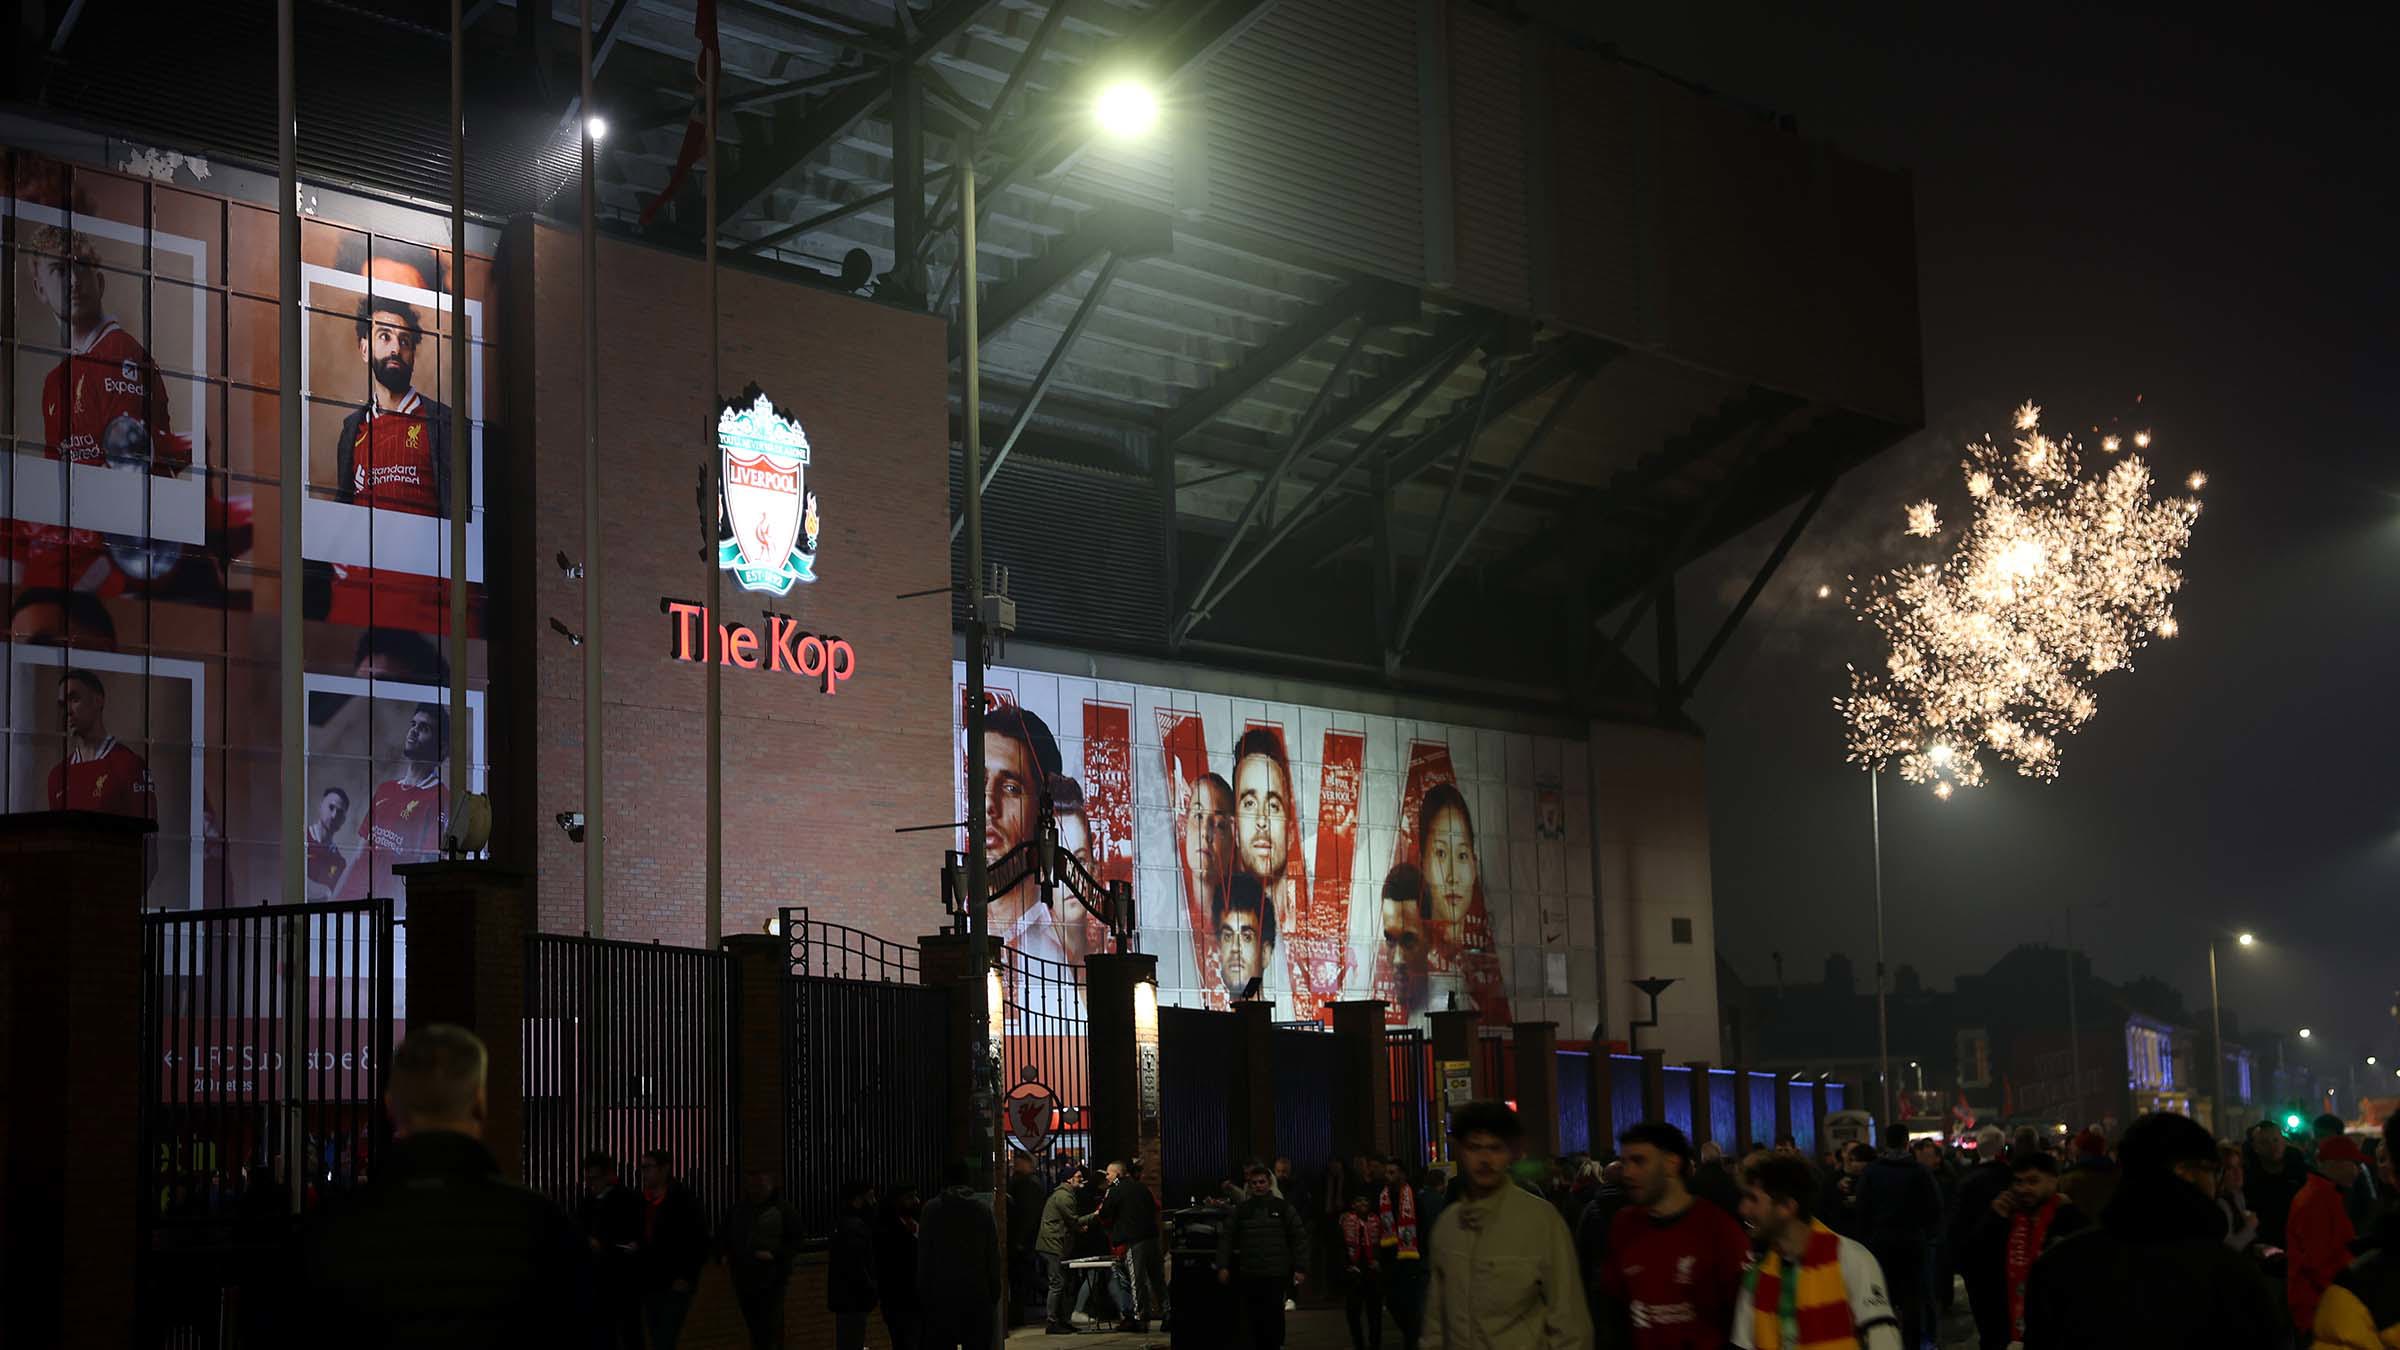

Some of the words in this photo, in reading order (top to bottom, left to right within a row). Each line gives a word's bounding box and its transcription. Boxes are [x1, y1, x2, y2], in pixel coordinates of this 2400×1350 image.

[104, 377, 145, 396] Exped
[370, 465, 417, 476] tandard
[730, 464, 797, 490] LIVERPOOL
[669, 602, 758, 669] The
[770, 615, 856, 695] Kop
[194, 1046, 234, 1071] LFC
